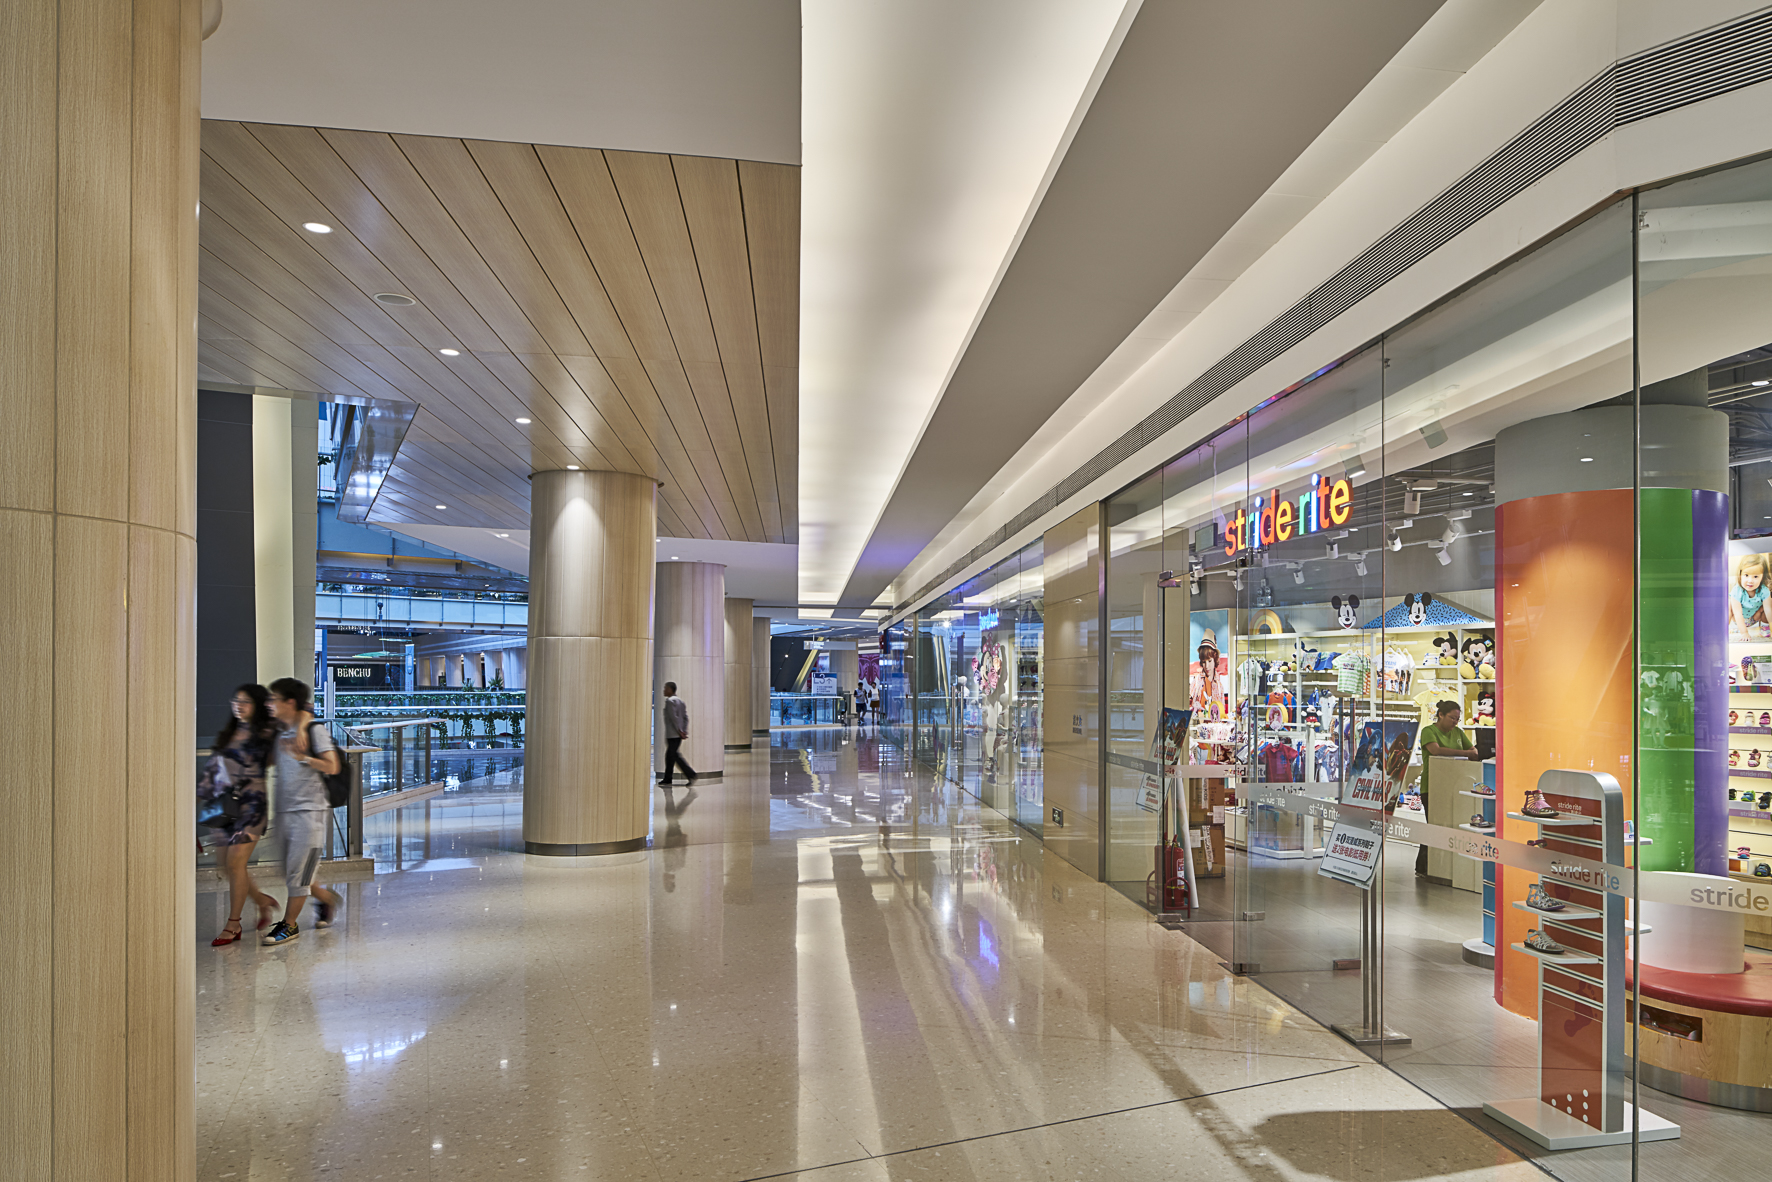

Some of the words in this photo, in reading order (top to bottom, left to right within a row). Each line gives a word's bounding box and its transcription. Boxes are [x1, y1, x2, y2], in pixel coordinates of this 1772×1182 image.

[1225, 489, 1295, 556] stride
[1299, 473, 1353, 535] rite
[337, 668, 371, 677] BENCHU
[1557, 802, 1572, 810] stride
[1394, 821, 1409, 838] rite
[1448, 836, 1479, 855] stride
[1480, 840, 1500, 860] rite
[1550, 859, 1591, 883] stride
[1594, 867, 1620, 891] rite
[1690, 886, 1770, 912] stride
